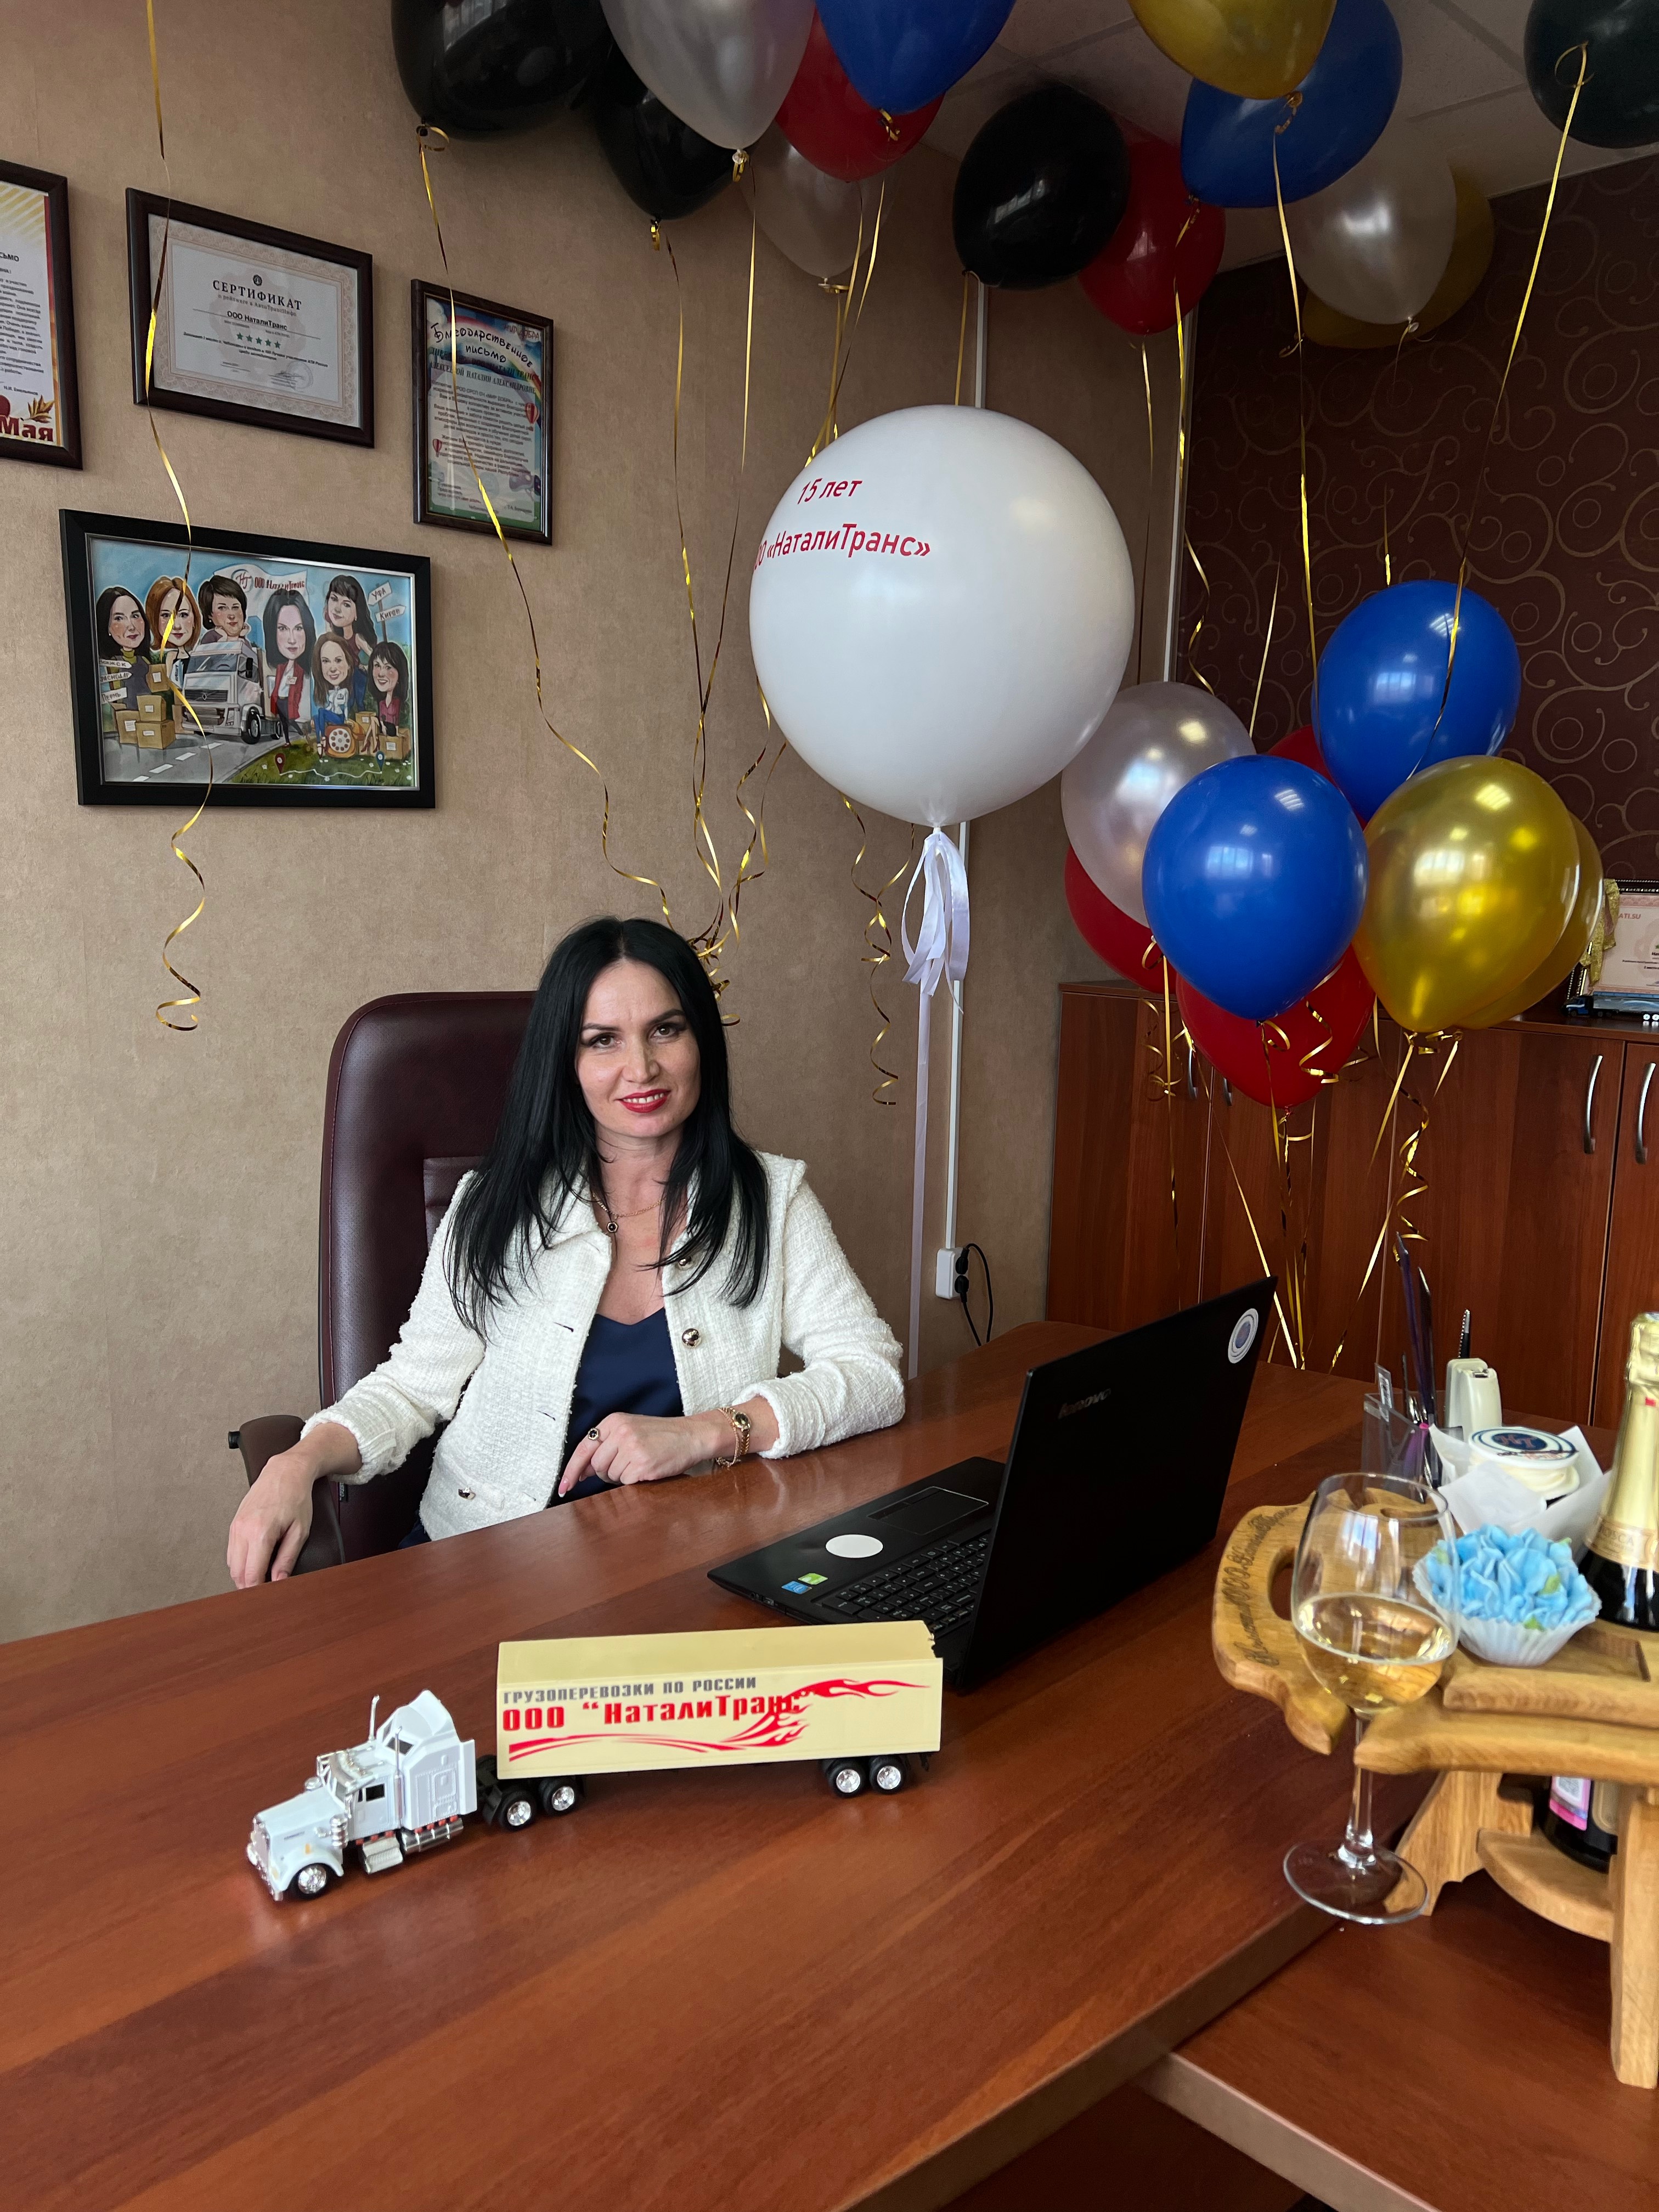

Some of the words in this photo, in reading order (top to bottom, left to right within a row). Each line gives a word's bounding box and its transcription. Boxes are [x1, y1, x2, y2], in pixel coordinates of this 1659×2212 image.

[213, 280, 301, 310] СЕРТИФИКАТ
[227, 311, 242, 319] ООО
[245, 314, 287, 330] НаталиТранс
[0, 415, 53, 442] Мая
[797, 478, 823, 504] 15
[819, 480, 862, 499] лет
[767, 523, 930, 558] «НаталиТранс»
[503, 1683, 654, 1705] ГРУЗОПЕРЕВОЗКИ
[663, 1680, 684, 1694] ПО
[692, 1677, 757, 1692] РОССИИ
[503, 1706, 565, 1731] ООО
